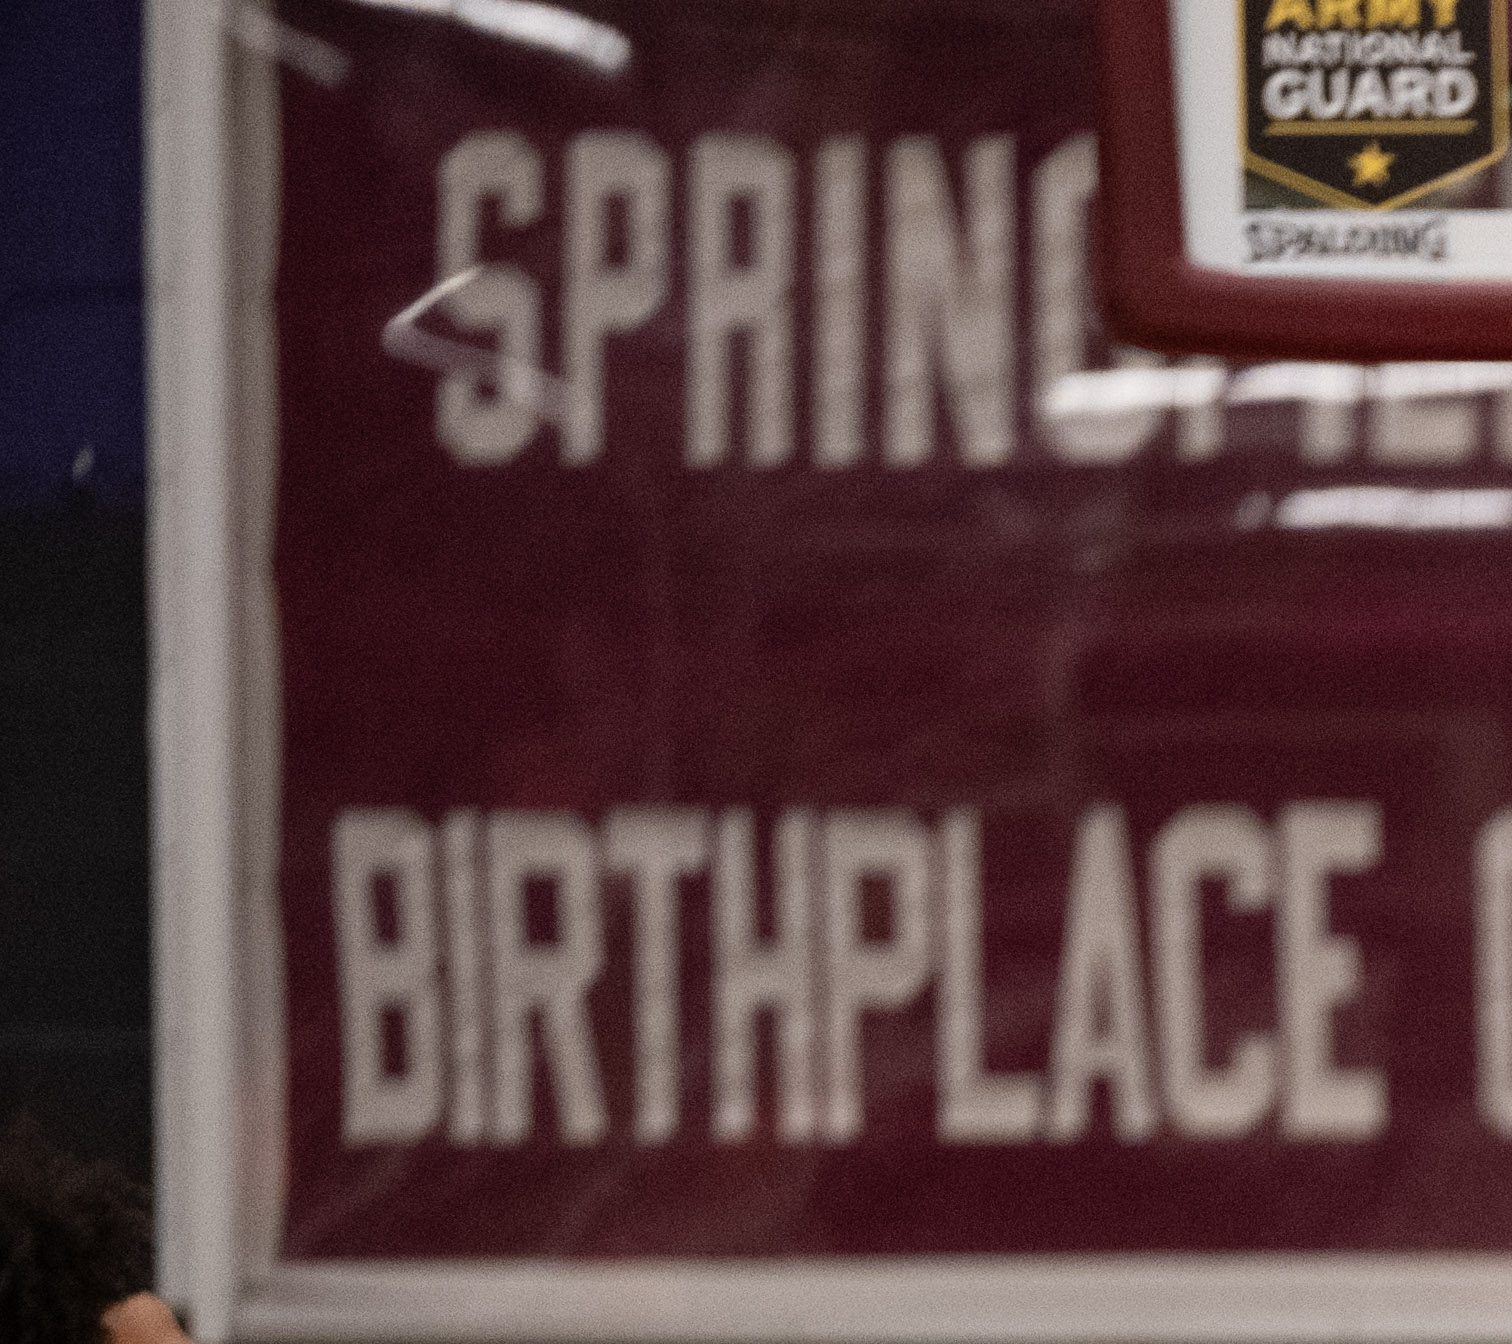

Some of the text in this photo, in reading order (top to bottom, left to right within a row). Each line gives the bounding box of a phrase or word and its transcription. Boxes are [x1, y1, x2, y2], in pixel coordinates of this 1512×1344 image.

[1262, 29, 1477, 66] NATIONAL
[1262, 66, 1479, 120] GUARD
[1245, 211, 1450, 263] SPALDING
[328, 803, 1390, 1150] BIRTHPLACE
